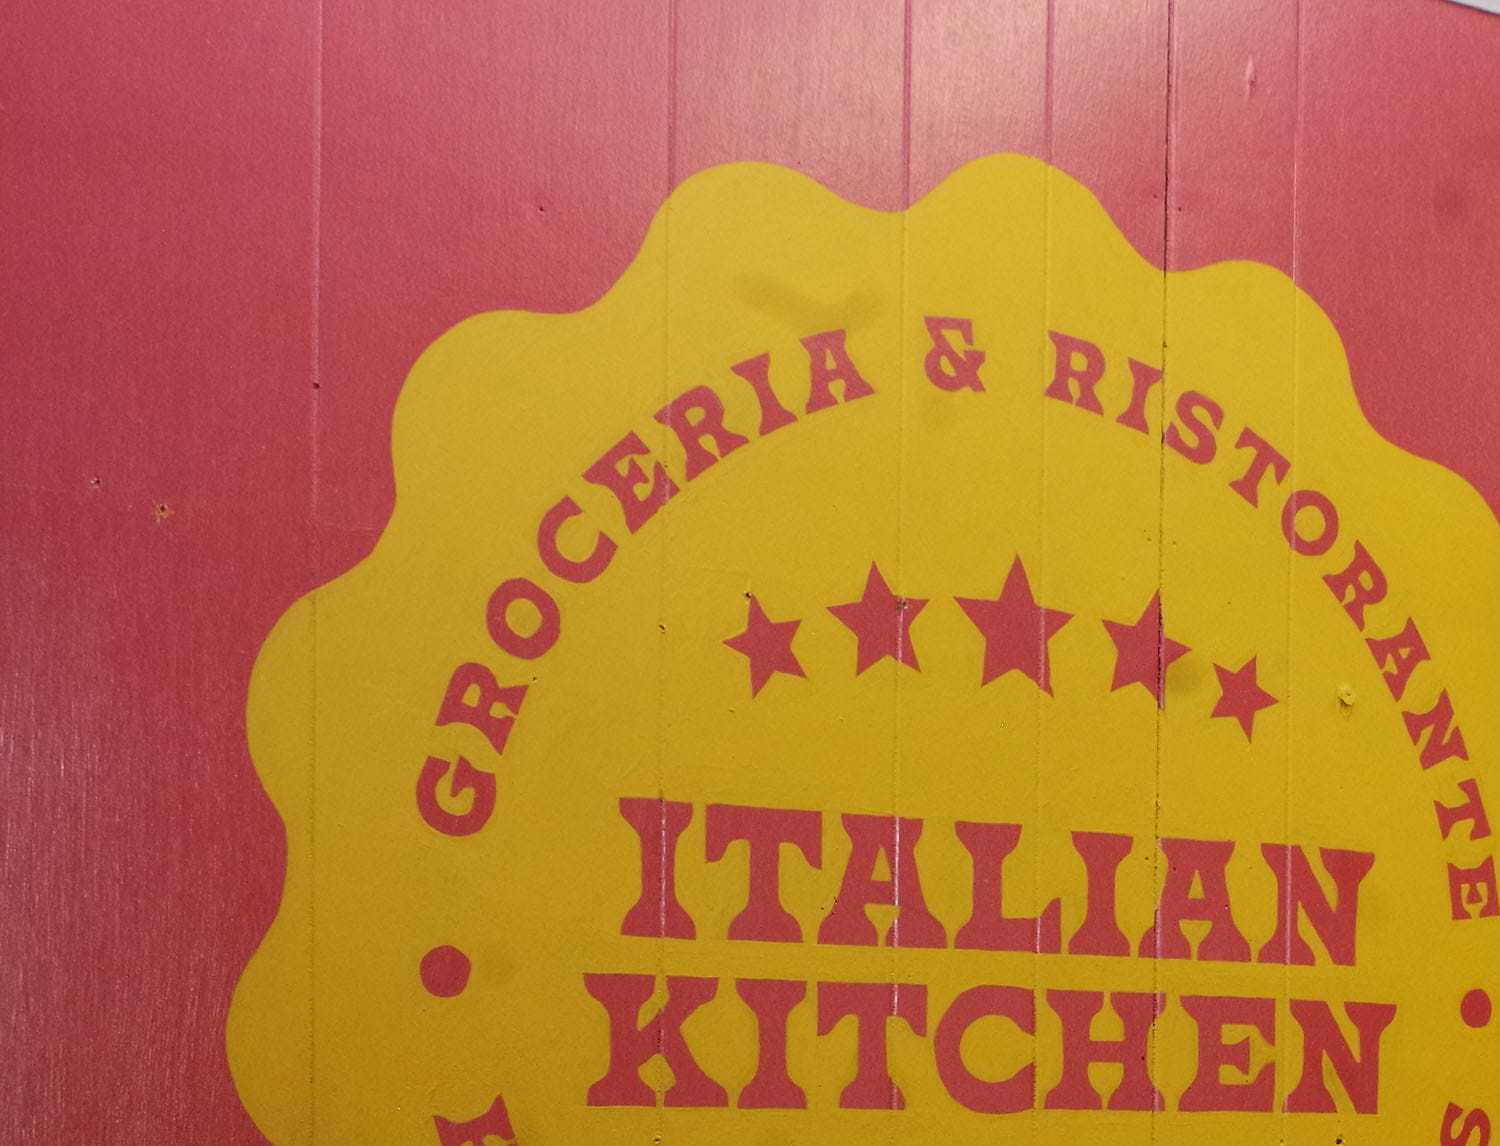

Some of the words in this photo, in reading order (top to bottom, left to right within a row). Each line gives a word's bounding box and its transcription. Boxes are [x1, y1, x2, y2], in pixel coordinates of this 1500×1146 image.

[415, 329, 876, 837] GROCERIA
[924, 316, 986, 393] &
[1044, 329, 1500, 921] RISTORANTE
[619, 796, 1376, 967] ITALIAN
[582, 972, 1398, 1115] KITCHEN
